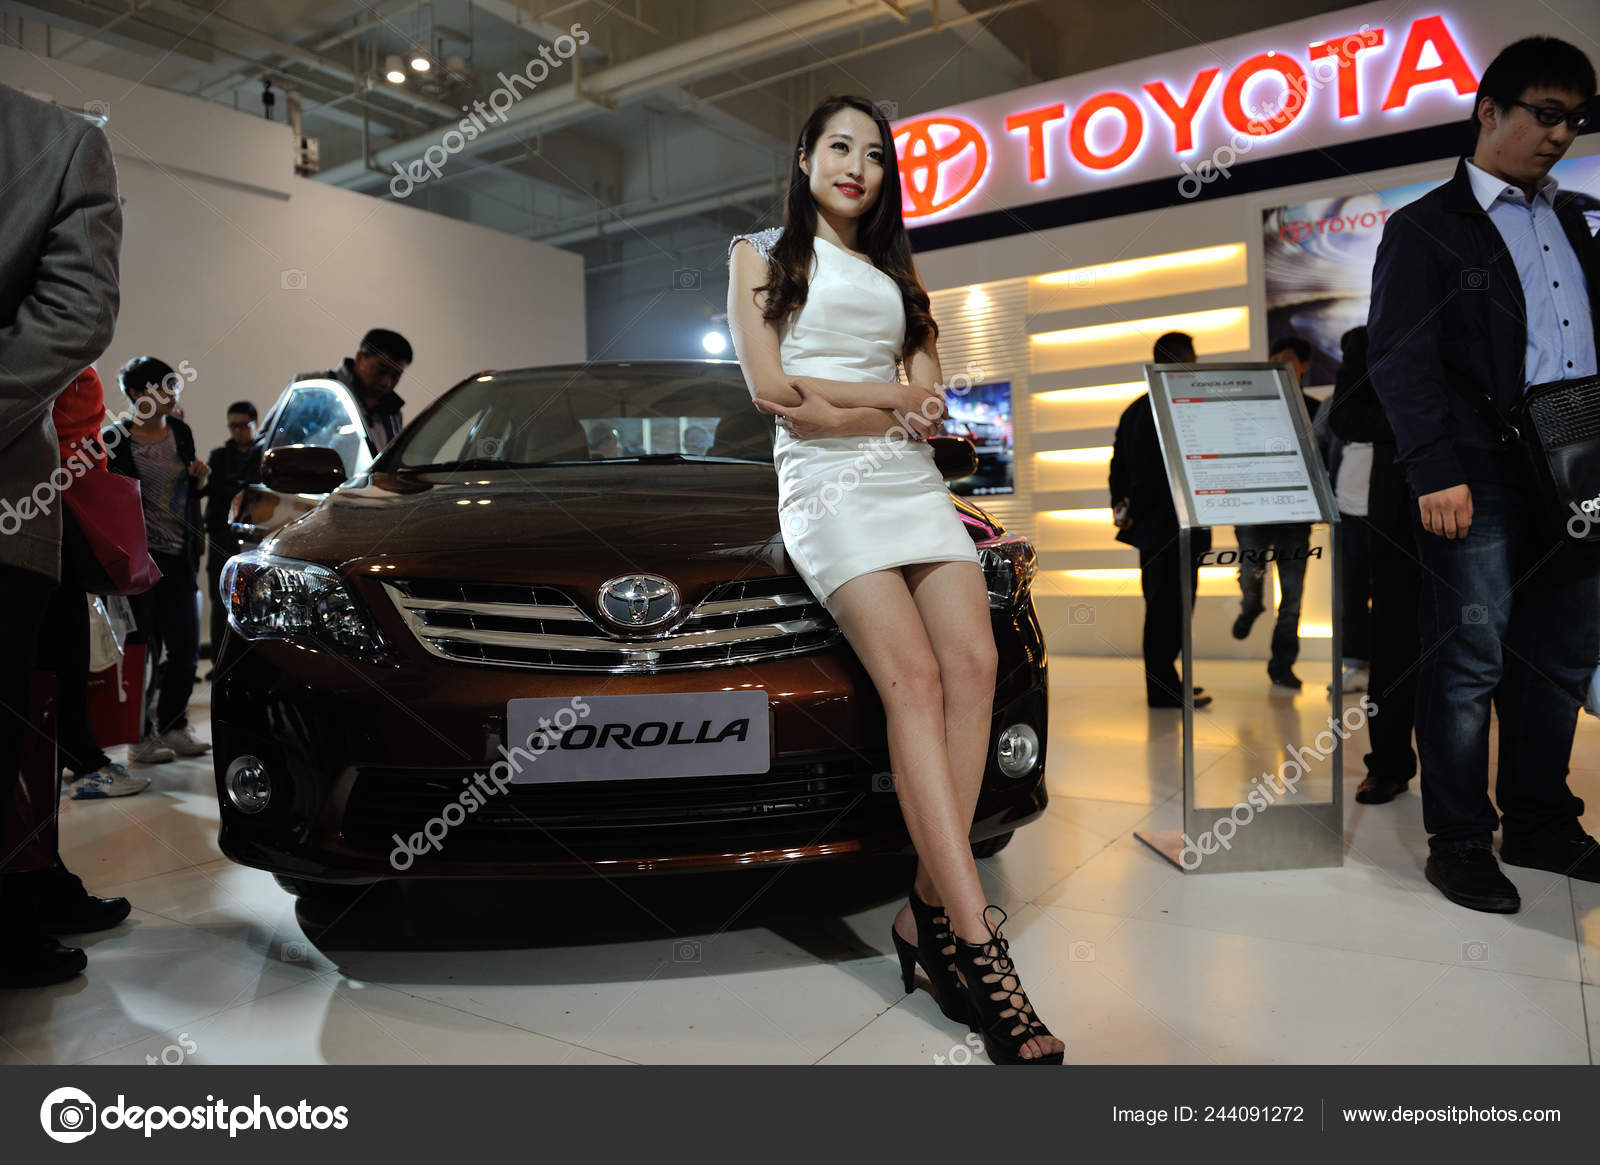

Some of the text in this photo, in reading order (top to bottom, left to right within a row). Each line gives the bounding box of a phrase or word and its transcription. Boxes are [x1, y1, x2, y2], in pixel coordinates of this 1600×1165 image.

[1005, 15, 1478, 183] TOYOTA
[1315, 208, 1399, 234] TOYOT
[528, 718, 750, 751] COROLLA
